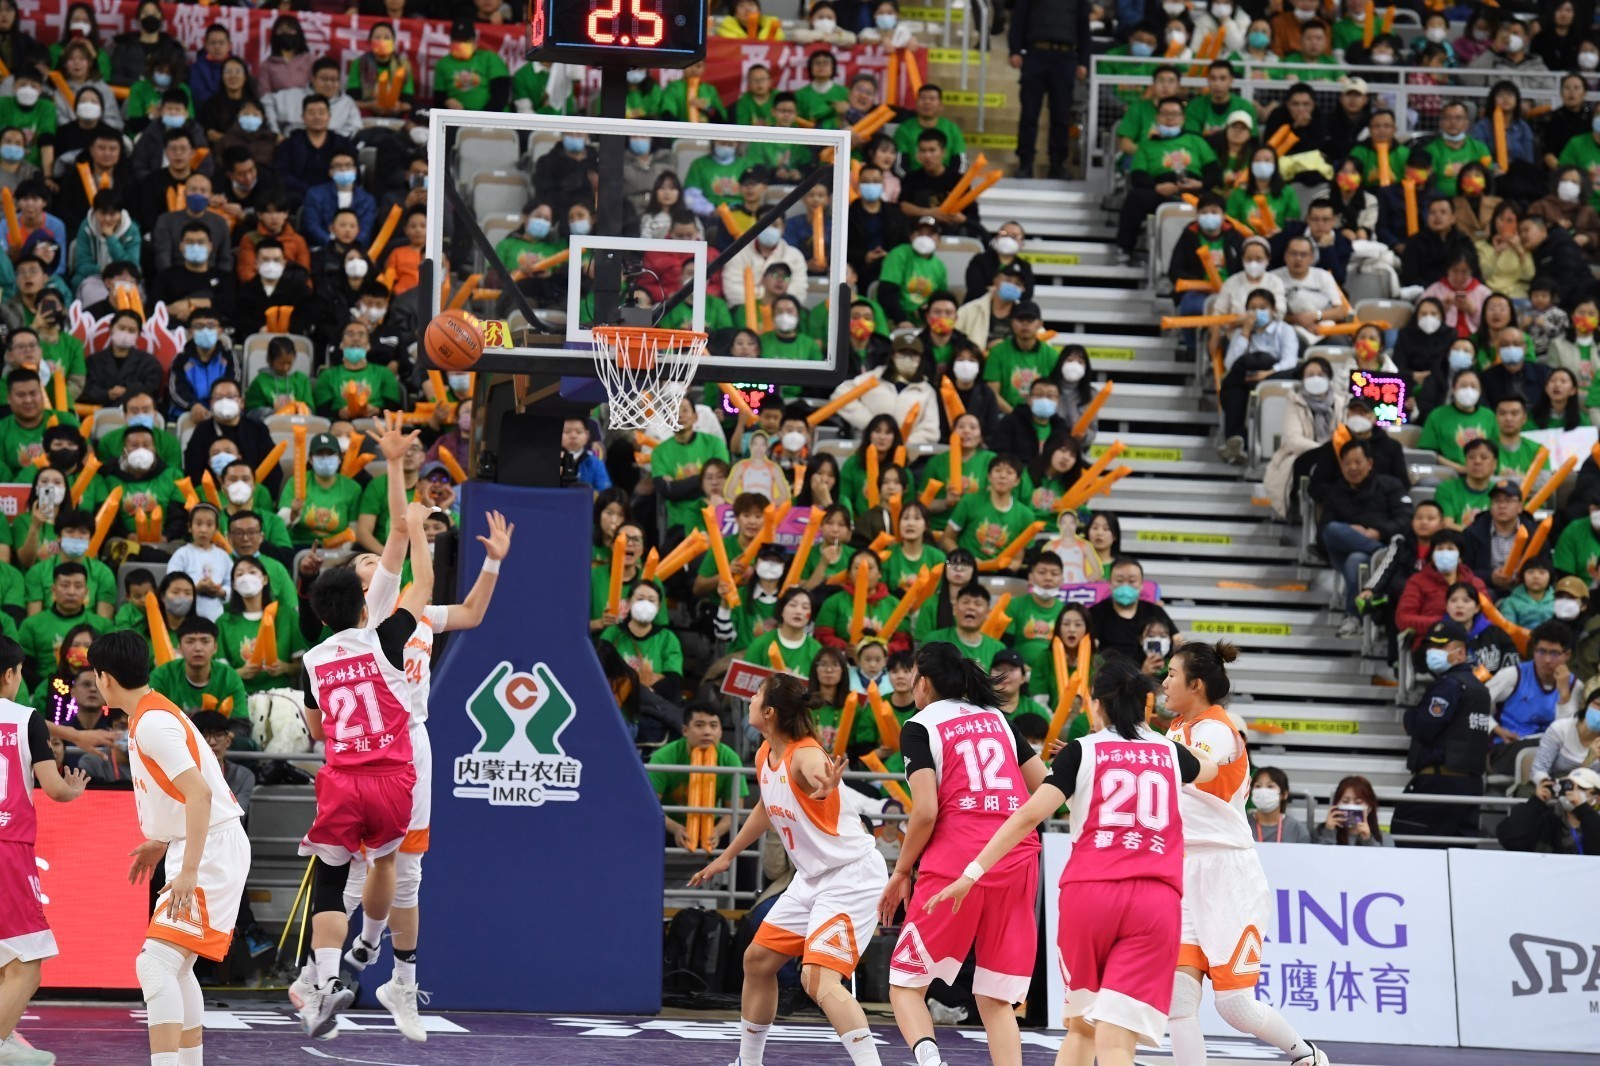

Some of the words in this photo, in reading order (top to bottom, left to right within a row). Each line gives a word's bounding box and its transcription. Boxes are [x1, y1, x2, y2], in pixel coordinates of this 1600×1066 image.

[588, 0, 663, 45] 2.5
[404, 658, 422, 684] 24
[328, 680, 385, 741] 21
[458, 758, 578, 784] 内蒙古农信
[955, 737, 1013, 791] 12
[492, 786, 542, 802] IMRC
[1098, 768, 1170, 832] 20
[782, 826, 795, 850] 7
[1094, 829, 1166, 855] 翟若云
[1263, 889, 1409, 949] ING
